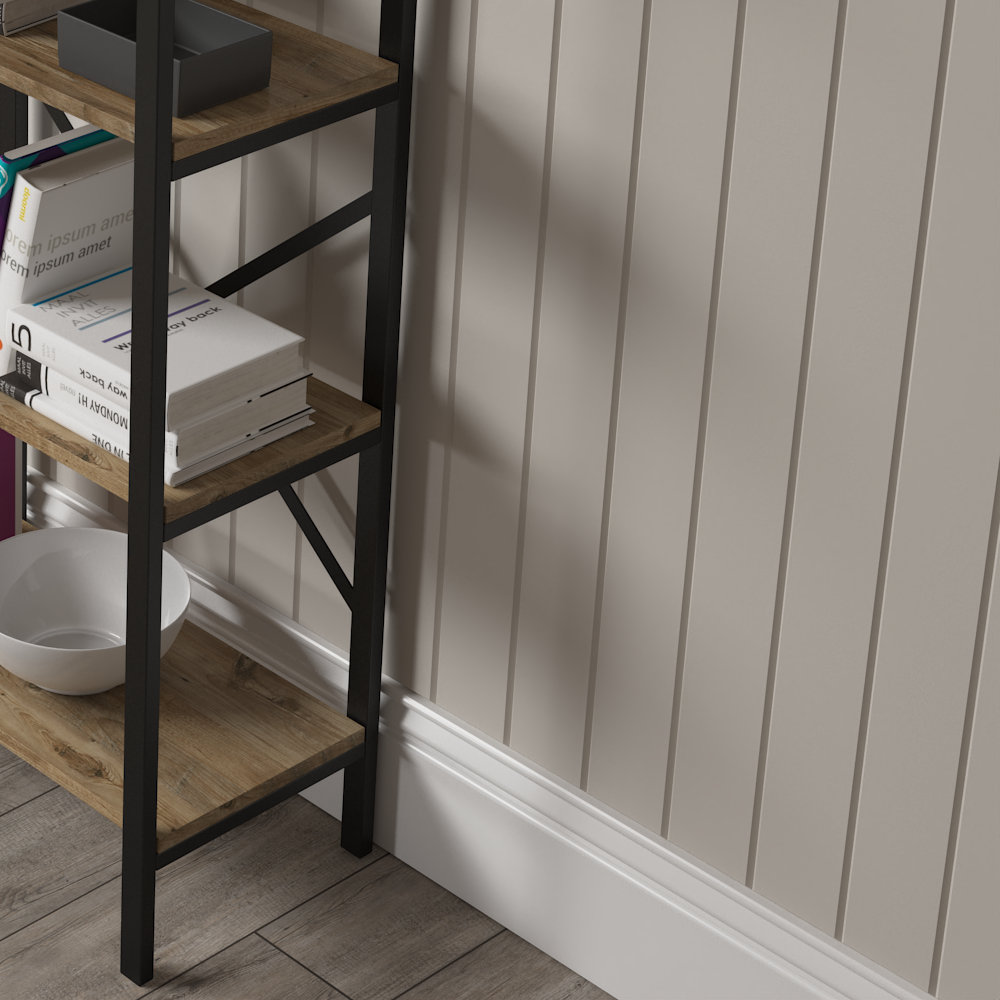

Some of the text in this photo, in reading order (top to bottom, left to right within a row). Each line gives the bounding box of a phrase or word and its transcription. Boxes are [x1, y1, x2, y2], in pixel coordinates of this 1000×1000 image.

[5, 209, 134, 257] orem ipsum ame
[1, 235, 112, 278] orem ipsum amet
[39, 291, 89, 312] MAAL
[55, 299, 98, 319] INVIT
[71, 305, 117, 327] ALLES
[167, 306, 222, 332] ay back
[11, 322, 31, 351] 5
[79, 368, 105, 389] back
[78, 393, 88, 408] H!
[107, 382, 128, 399] way
[89, 399, 128, 430] MONDAY
